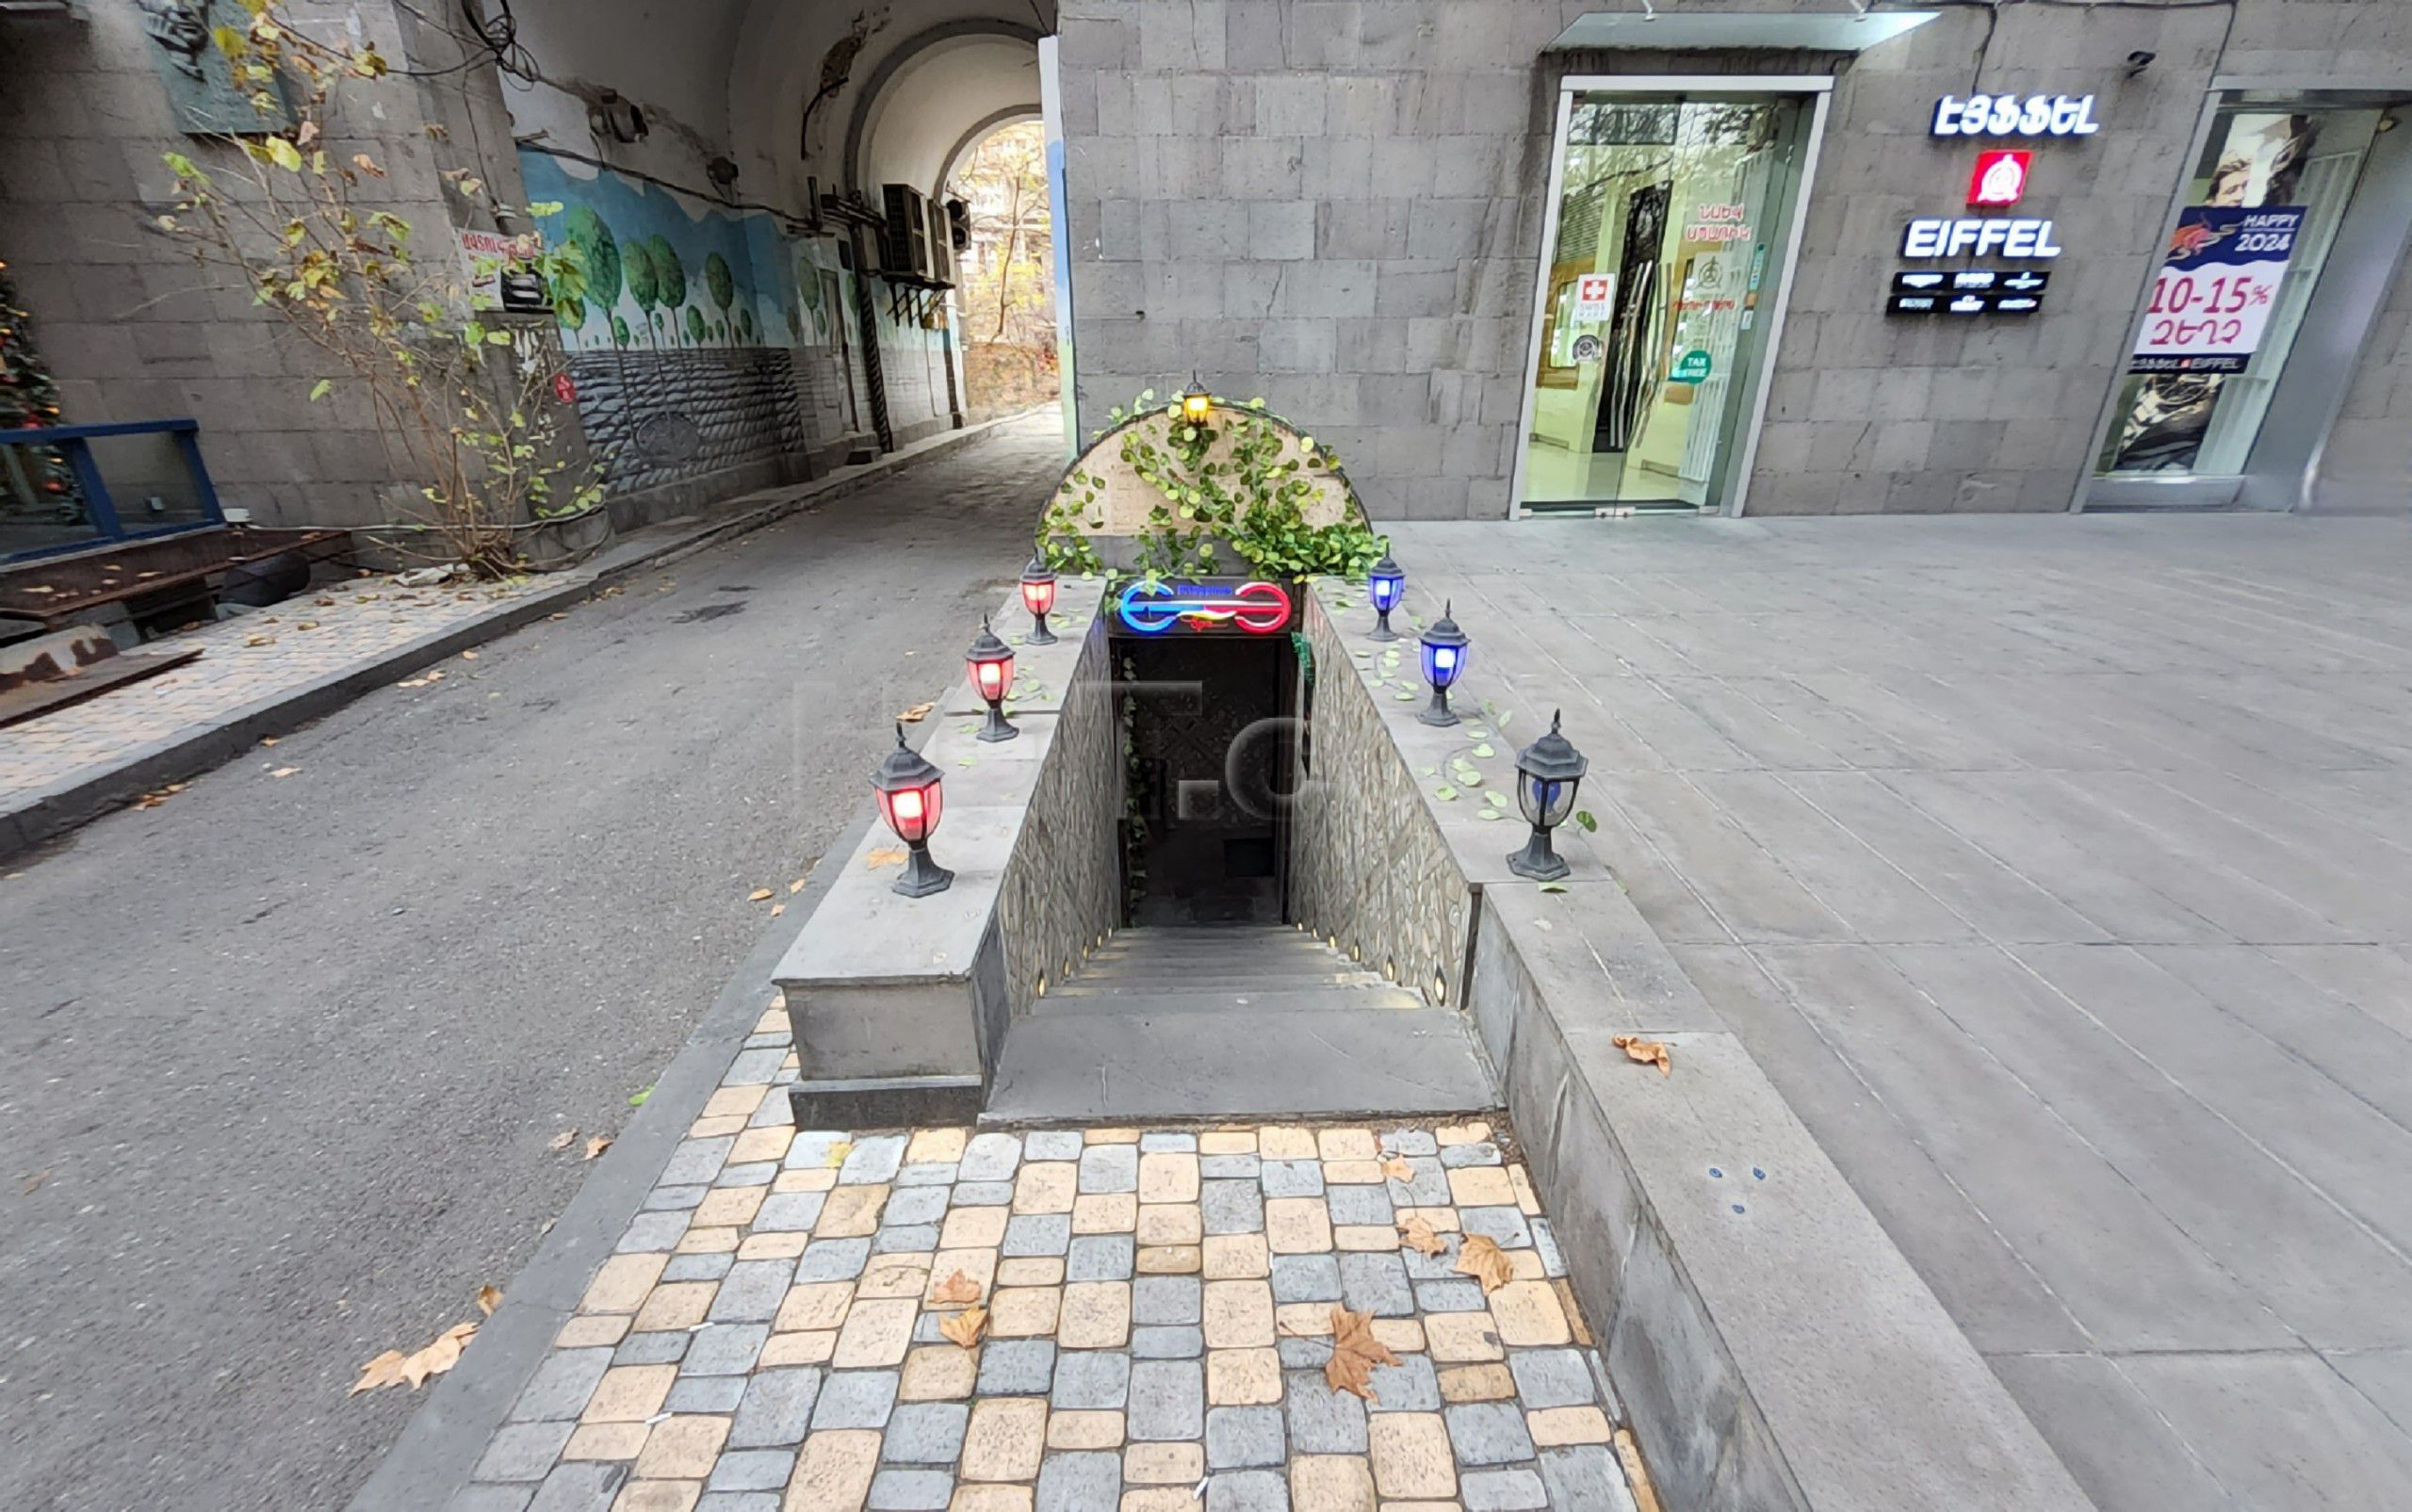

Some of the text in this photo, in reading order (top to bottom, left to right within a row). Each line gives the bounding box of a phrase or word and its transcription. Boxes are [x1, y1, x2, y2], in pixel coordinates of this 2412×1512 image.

[1932, 94, 2099, 136] ԷՅՖՖԵԼ
[2242, 214, 2301, 228] HAPPY
[1903, 219, 2062, 257] EIFFEL
[2233, 234, 2292, 252] 2024
[2146, 277, 2273, 314] 10-15%
[1687, 357, 1707, 367] TAX
